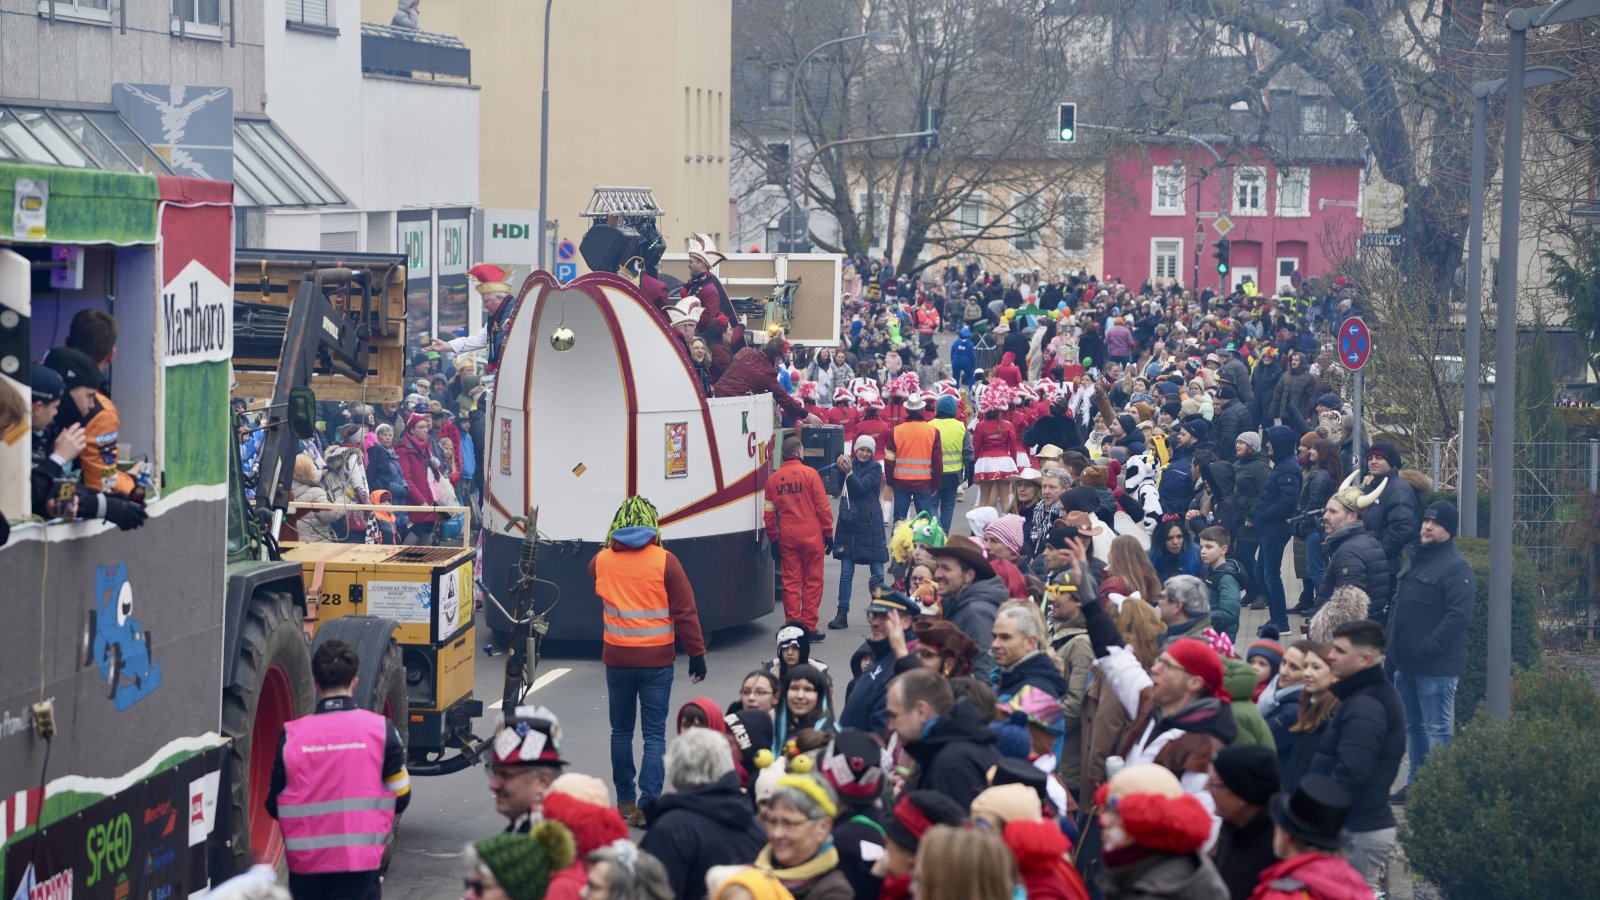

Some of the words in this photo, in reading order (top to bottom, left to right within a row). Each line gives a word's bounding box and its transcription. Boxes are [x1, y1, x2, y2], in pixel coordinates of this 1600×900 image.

[405, 231, 424, 268] HDI
[445, 227, 462, 266] HDI
[492, 223, 529, 239] HDI
[559, 265, 571, 280] P
[163, 280, 225, 357] Marlboro
[321, 593, 342, 606] 28
[87, 812, 132, 887] SPEED
